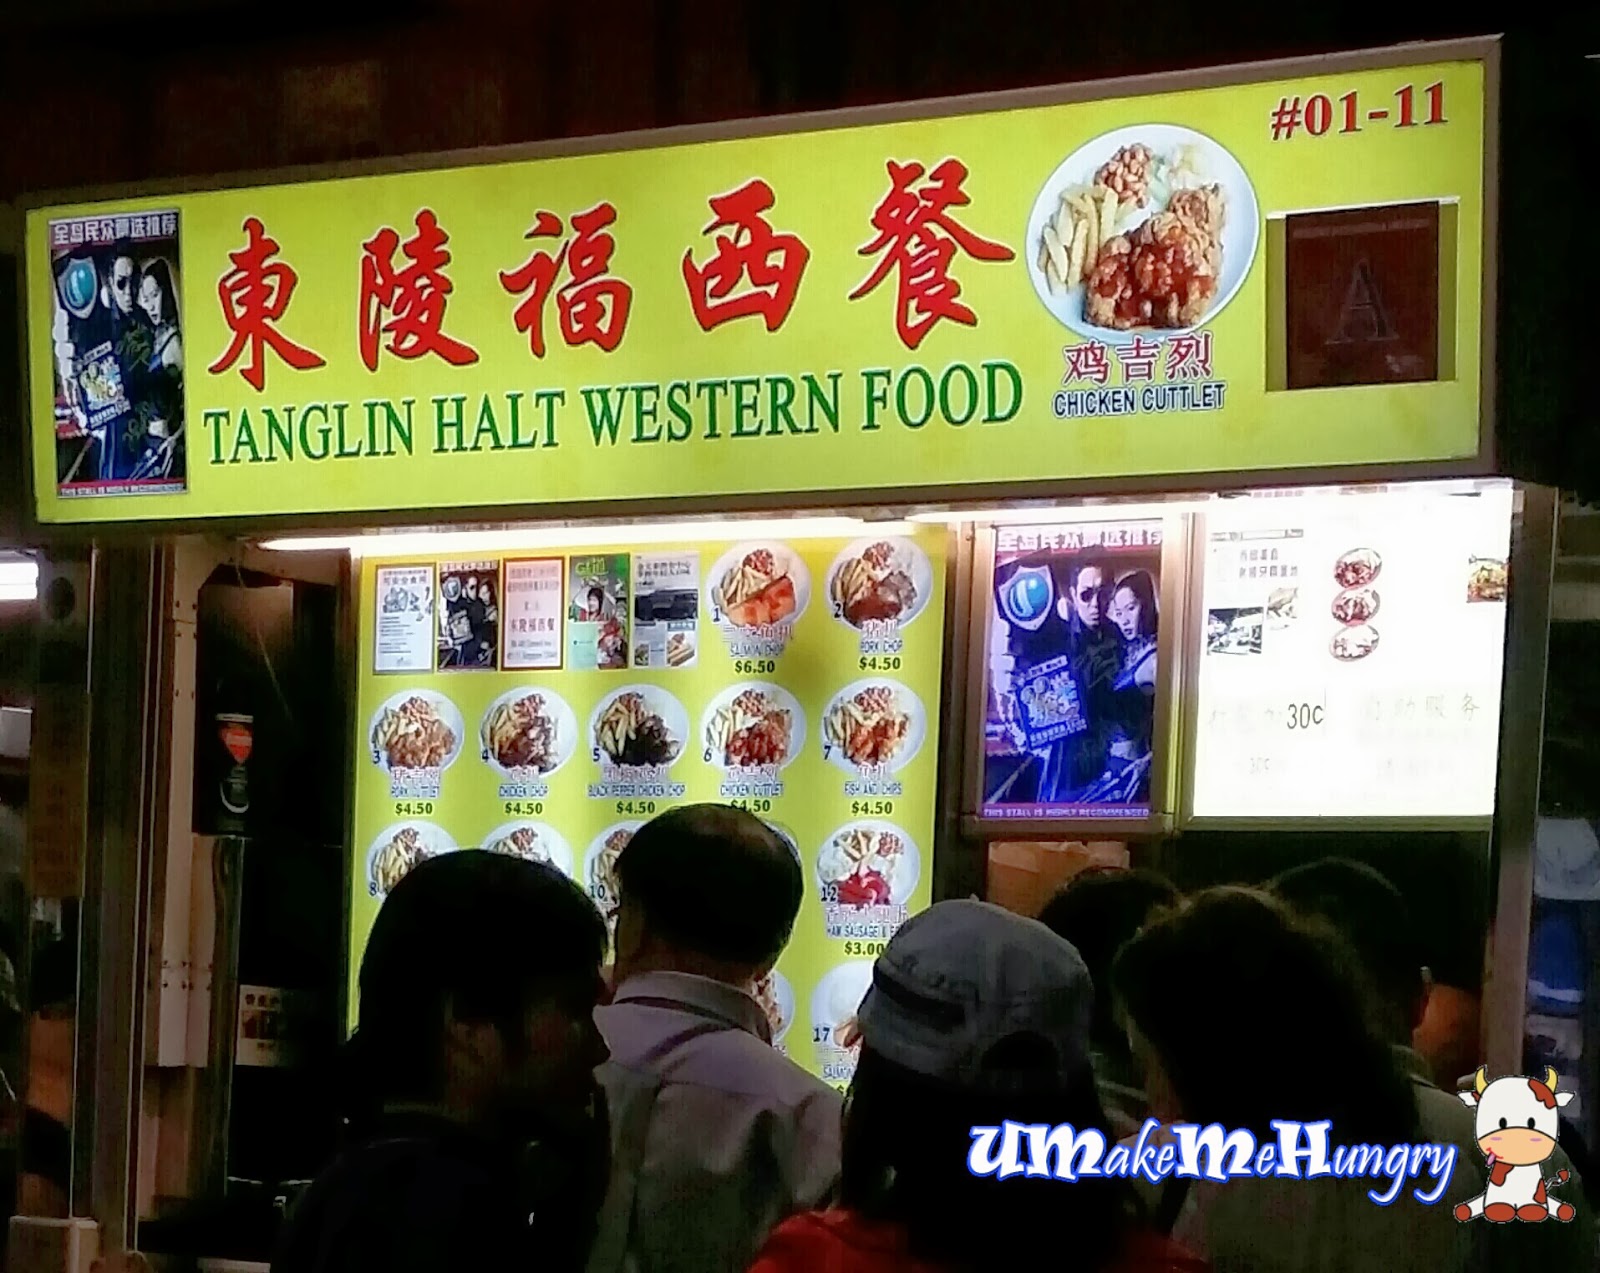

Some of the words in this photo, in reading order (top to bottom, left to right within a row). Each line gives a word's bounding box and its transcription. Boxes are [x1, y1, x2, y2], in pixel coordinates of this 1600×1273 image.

[1271, 82, 1448, 140] #01-11
[208, 157, 1015, 393] 東陵福西餐
[1326, 257, 1398, 345] A
[1063, 331, 1214, 385] 鸡吉烈
[1054, 387, 1135, 418] CHICKEN
[1141, 382, 1226, 413] CUTTLET
[204, 399, 415, 465] TANGLIN
[433, 389, 565, 453] HALT
[581, 372, 843, 447] WESTERN
[861, 360, 1023, 432] FOOD
[713, 608, 720, 622] 1
[834, 603, 843, 618] 2
[735, 660, 775, 674] $6.50
[859, 657, 901, 671] $4.50
[372, 752, 380, 764] 3
[481, 751, 489, 763] 4
[593, 748, 600, 761] 5
[703, 749, 712, 762] 6
[823, 746, 832, 760] 7
[395, 803, 433, 815] $4.50
[505, 803, 543, 815] $4.50
[616, 801, 655, 814] $4.50
[730, 799, 771, 813] $4.50
[852, 801, 892, 815] $4.50
[368, 882, 377, 897] 8
[591, 885, 606, 900] 10
[821, 886, 836, 902] 12
[844, 941, 885, 955] $3.00
[813, 1027, 830, 1042] 17
